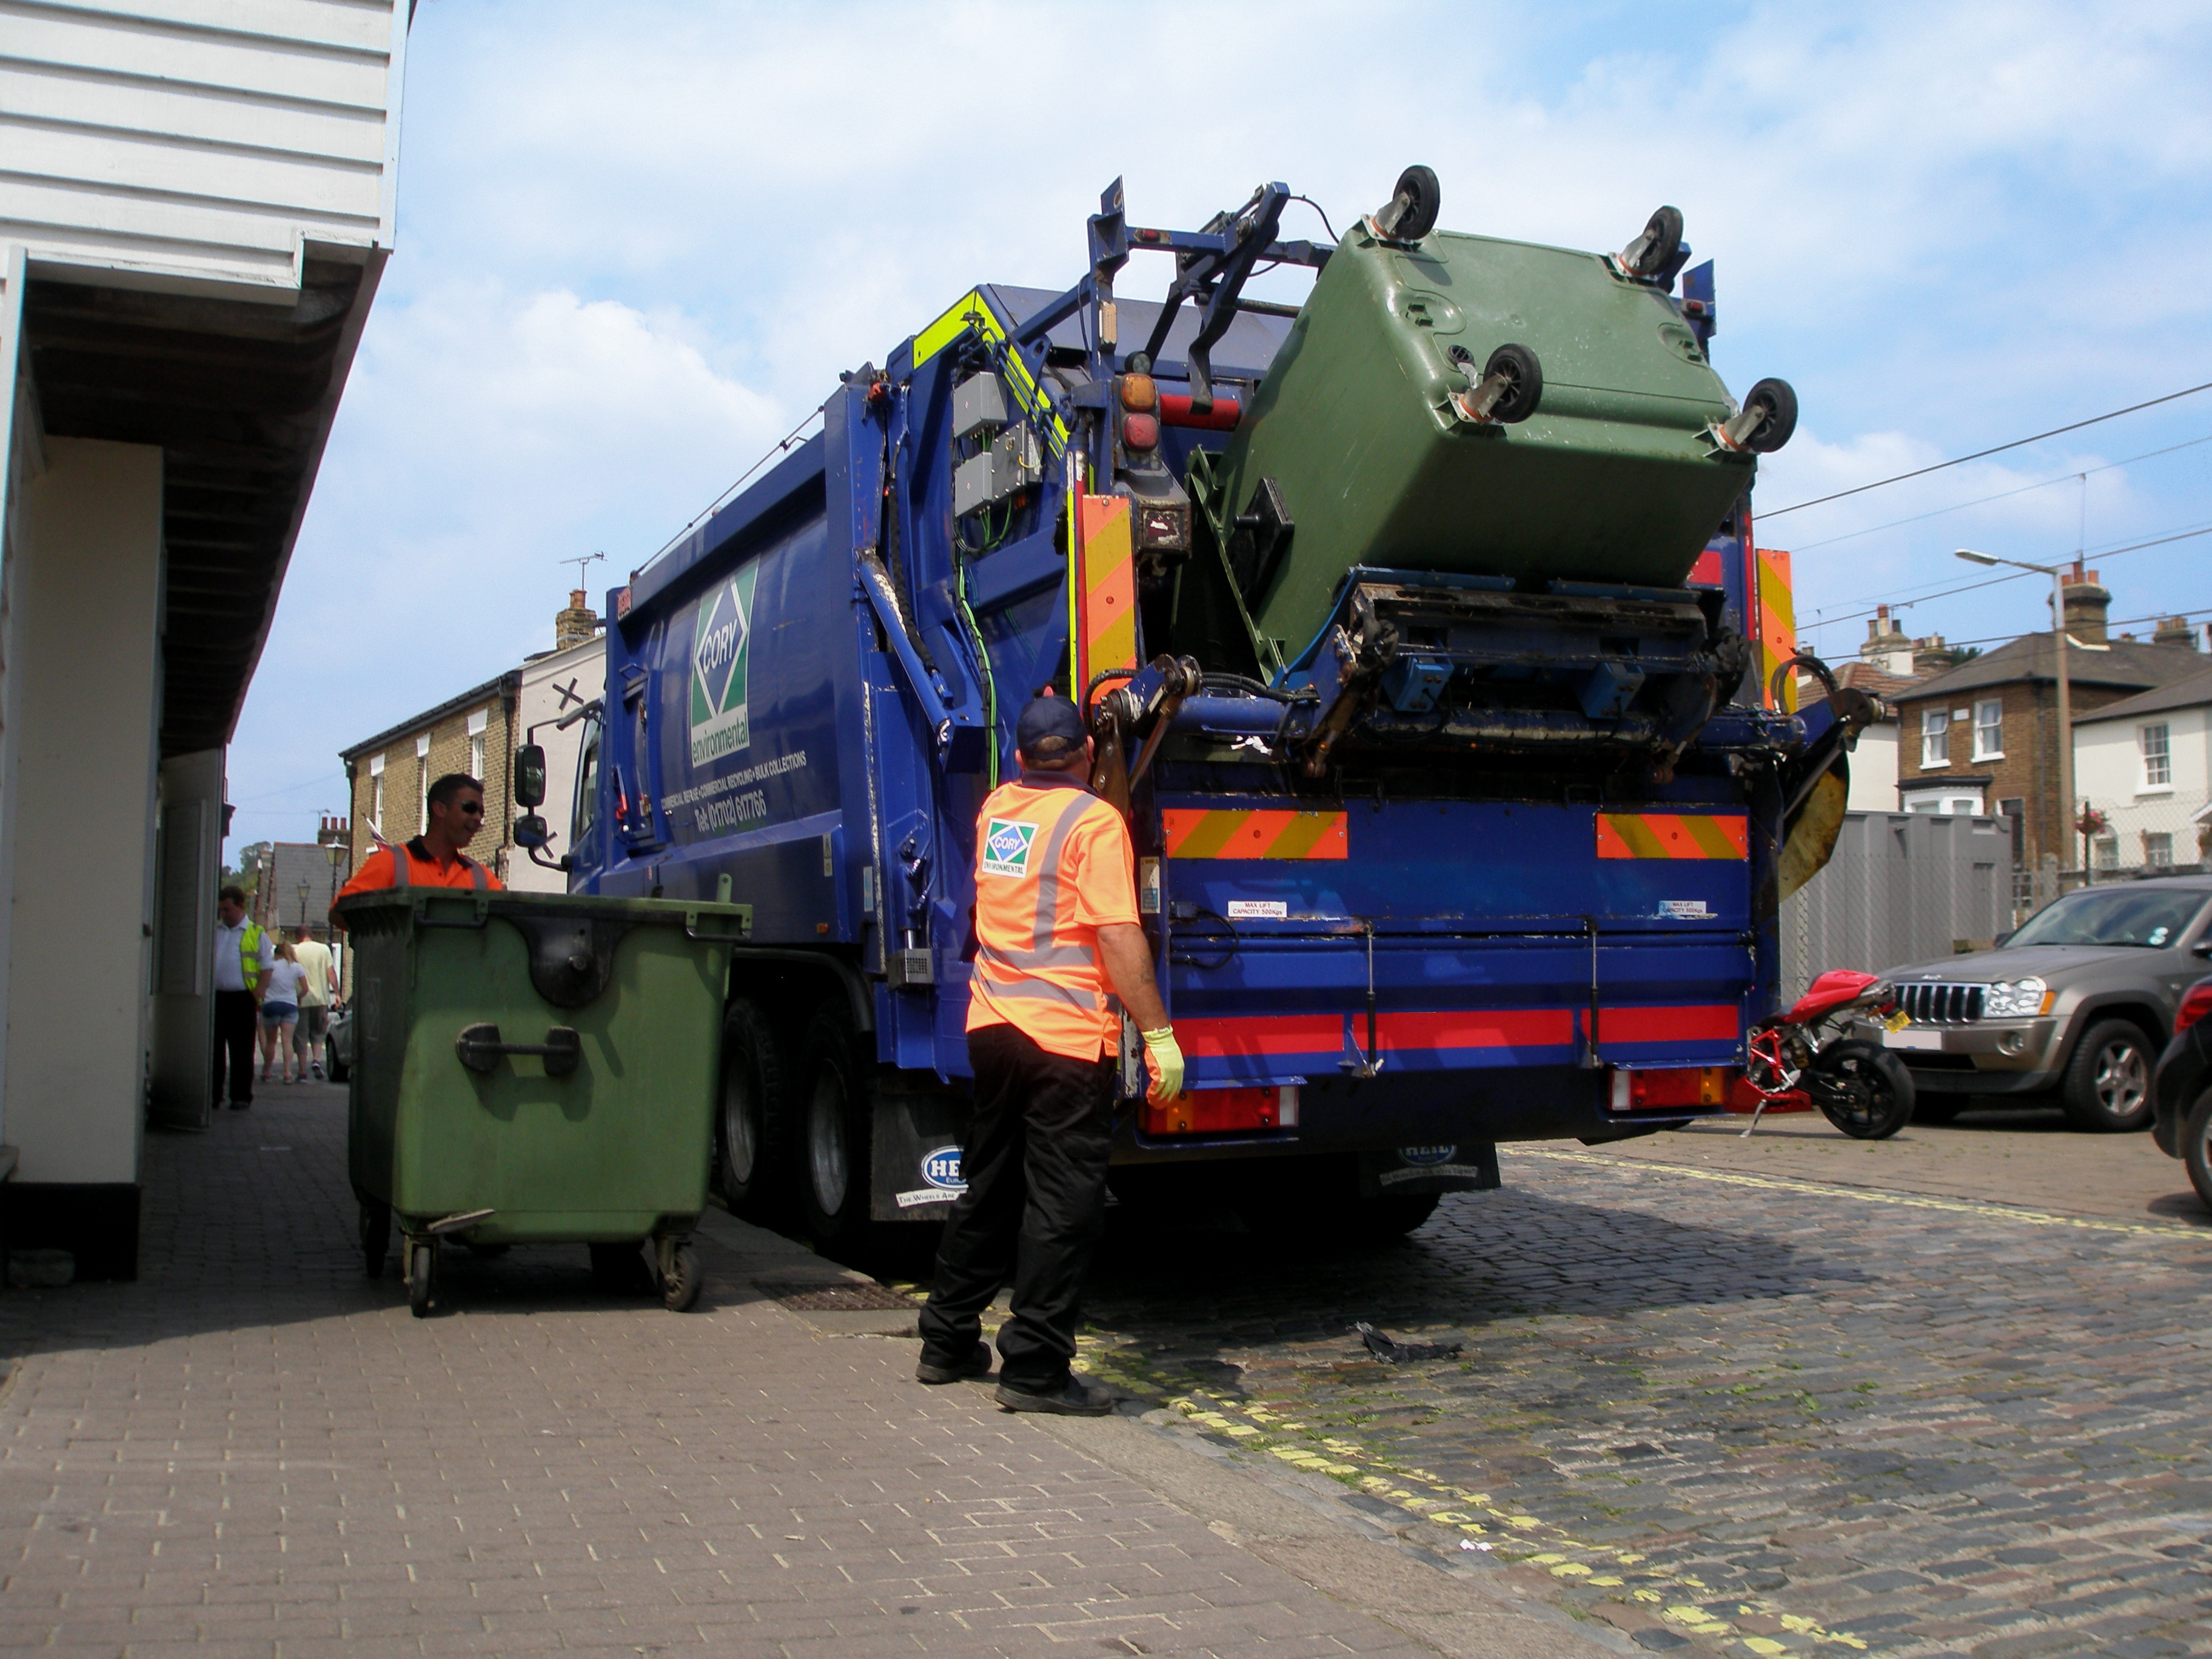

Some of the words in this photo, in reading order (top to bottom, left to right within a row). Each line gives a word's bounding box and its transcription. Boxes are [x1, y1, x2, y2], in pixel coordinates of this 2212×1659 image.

[703, 618, 737, 674] CORY
[692, 712, 748, 763] environmental
[727, 768, 753, 789] RECYCLING
[754, 762, 770, 781] BULK
[768, 750, 806, 776] COLLECTIONS
[694, 806, 709, 832] Tel:
[708, 794, 737, 832] (01702)
[735, 789, 766, 822] 617766
[994, 836, 1021, 851] CORY
[984, 861, 1024, 874] ENVIRONMENTAL
[931, 1159, 960, 1177] HE
